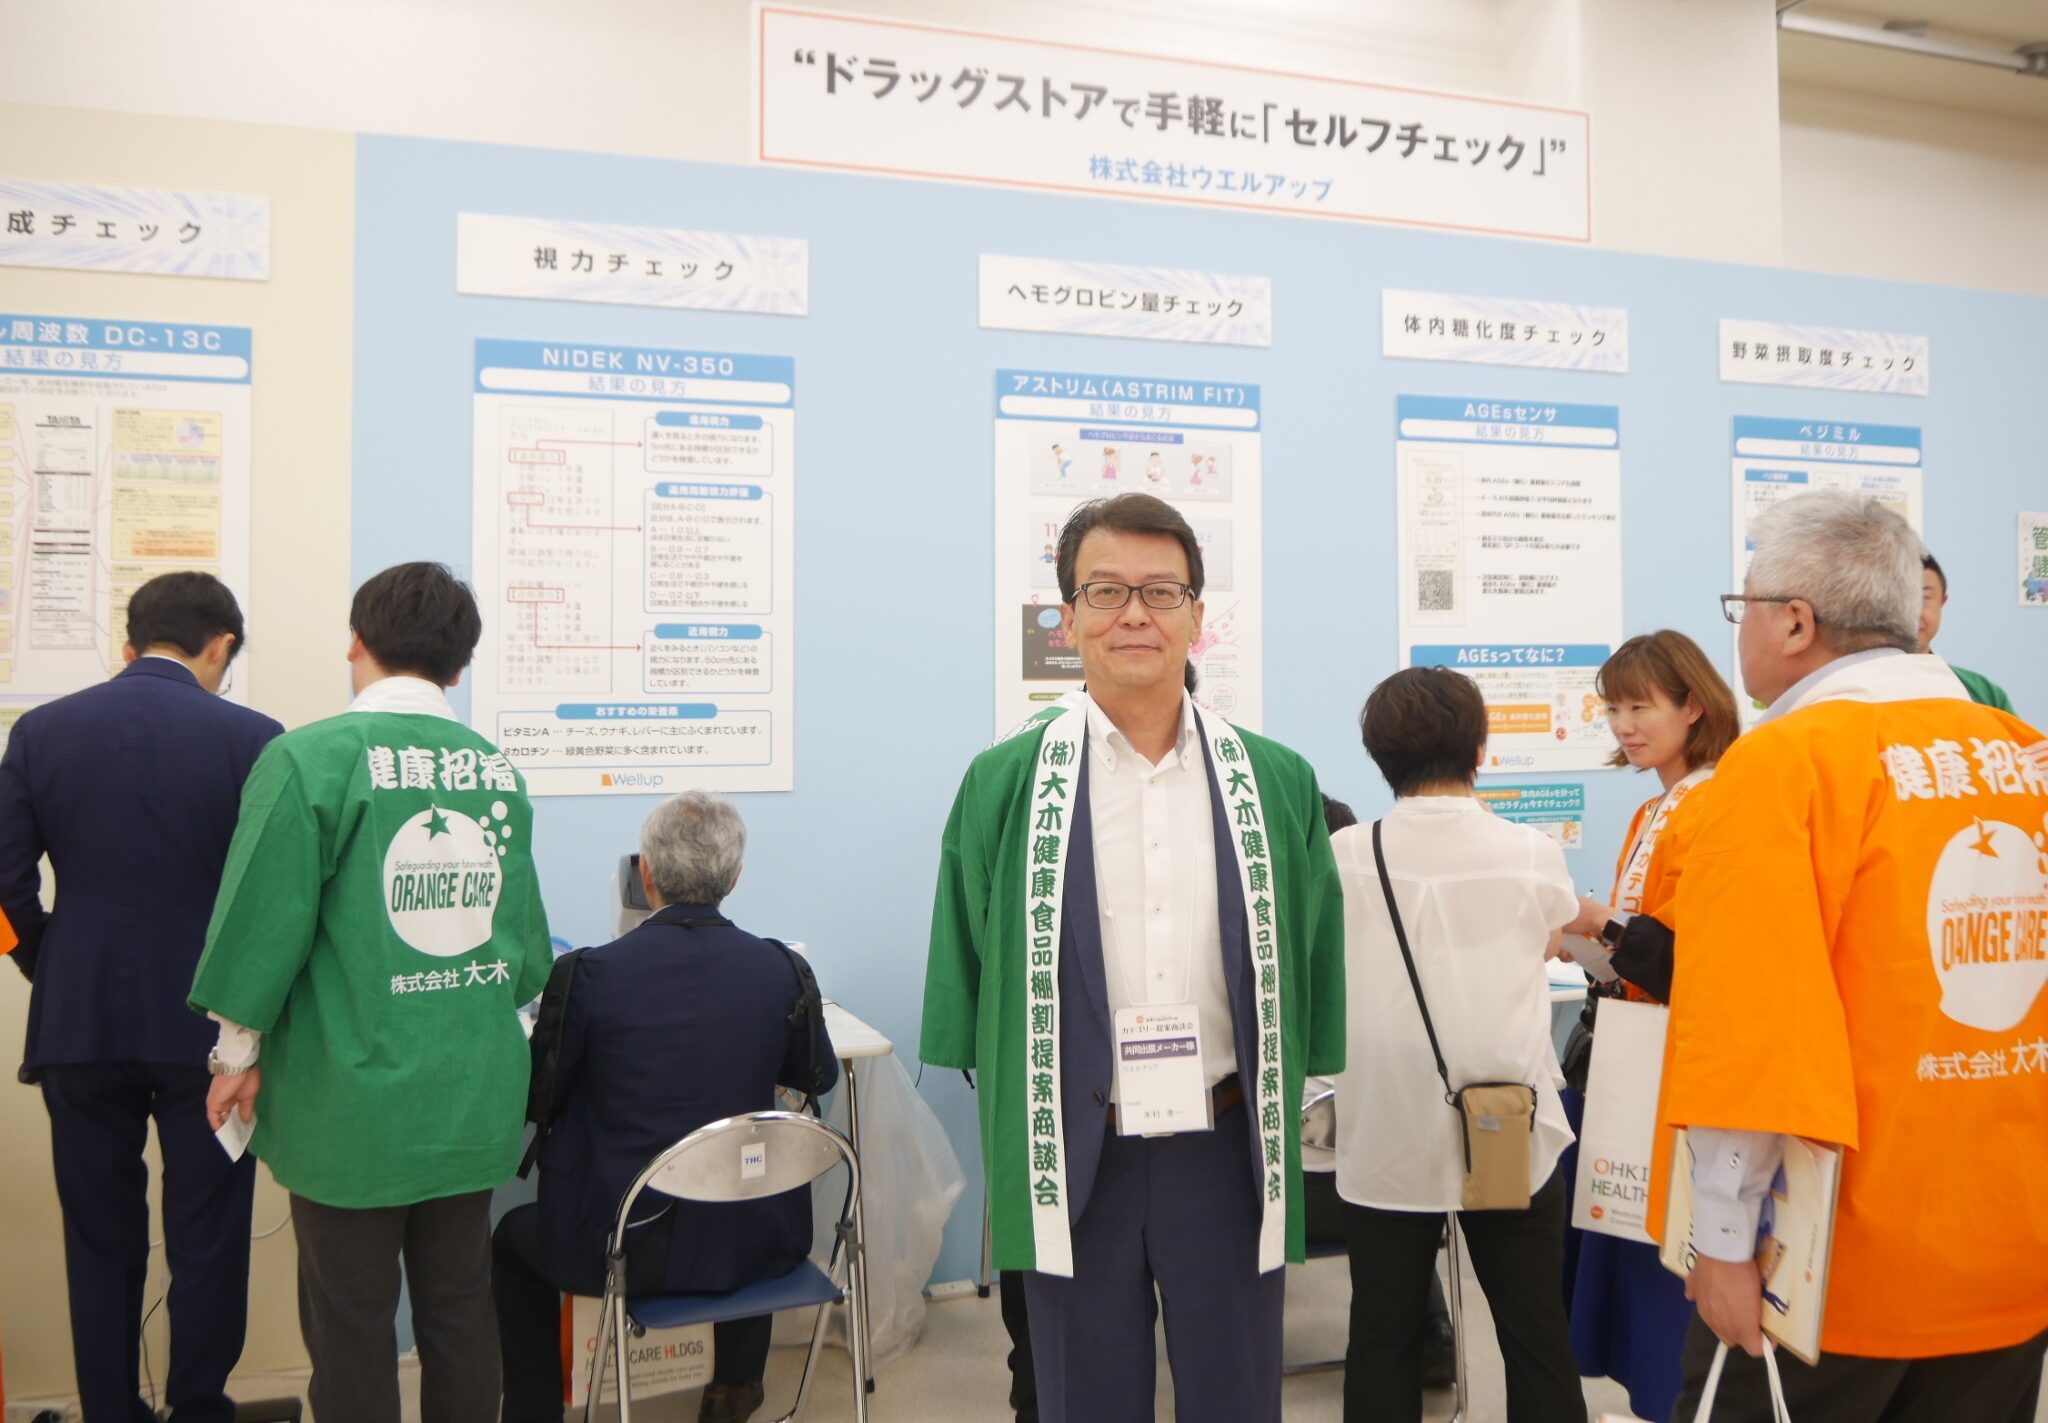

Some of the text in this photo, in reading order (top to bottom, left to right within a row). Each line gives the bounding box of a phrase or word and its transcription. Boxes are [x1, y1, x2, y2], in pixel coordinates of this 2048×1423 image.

[1089, 153, 1335, 203] 株式会社ウエルアップ
[7, 209, 202, 245] 成チェック
[533, 246, 735, 282] 視力チェック
[1007, 283, 1244, 318] ヘモグロビン量チェック
[104, 325, 222, 351] DC-13C
[1403, 313, 1607, 347] 体内糖化度チェック
[4, 348, 124, 371] 結果の見方
[542, 348, 735, 376] NIDEK NV-350
[1731, 340, 1917, 373] 野菜摂取度チェック
[587, 375, 687, 397] 結果の見方
[1088, 402, 1172, 422] 結果の見方
[1463, 401, 1558, 422] AGEsセンサ
[1475, 423, 1545, 442] 結果の見方
[1799, 443, 1859, 460] 結果の見方
[503, 727, 550, 737] ビタミンA
[366, 745, 518, 792] 健康招福
[1499, 755, 1535, 767] Wellup
[612, 773, 664, 788] Wellup
[394, 860, 441, 873] Safeguarding
[391, 871, 496, 913] ORANGE CARE
[1594, 1158, 1650, 1182] OHKI
[664, 1340, 704, 1361] HLDGS
